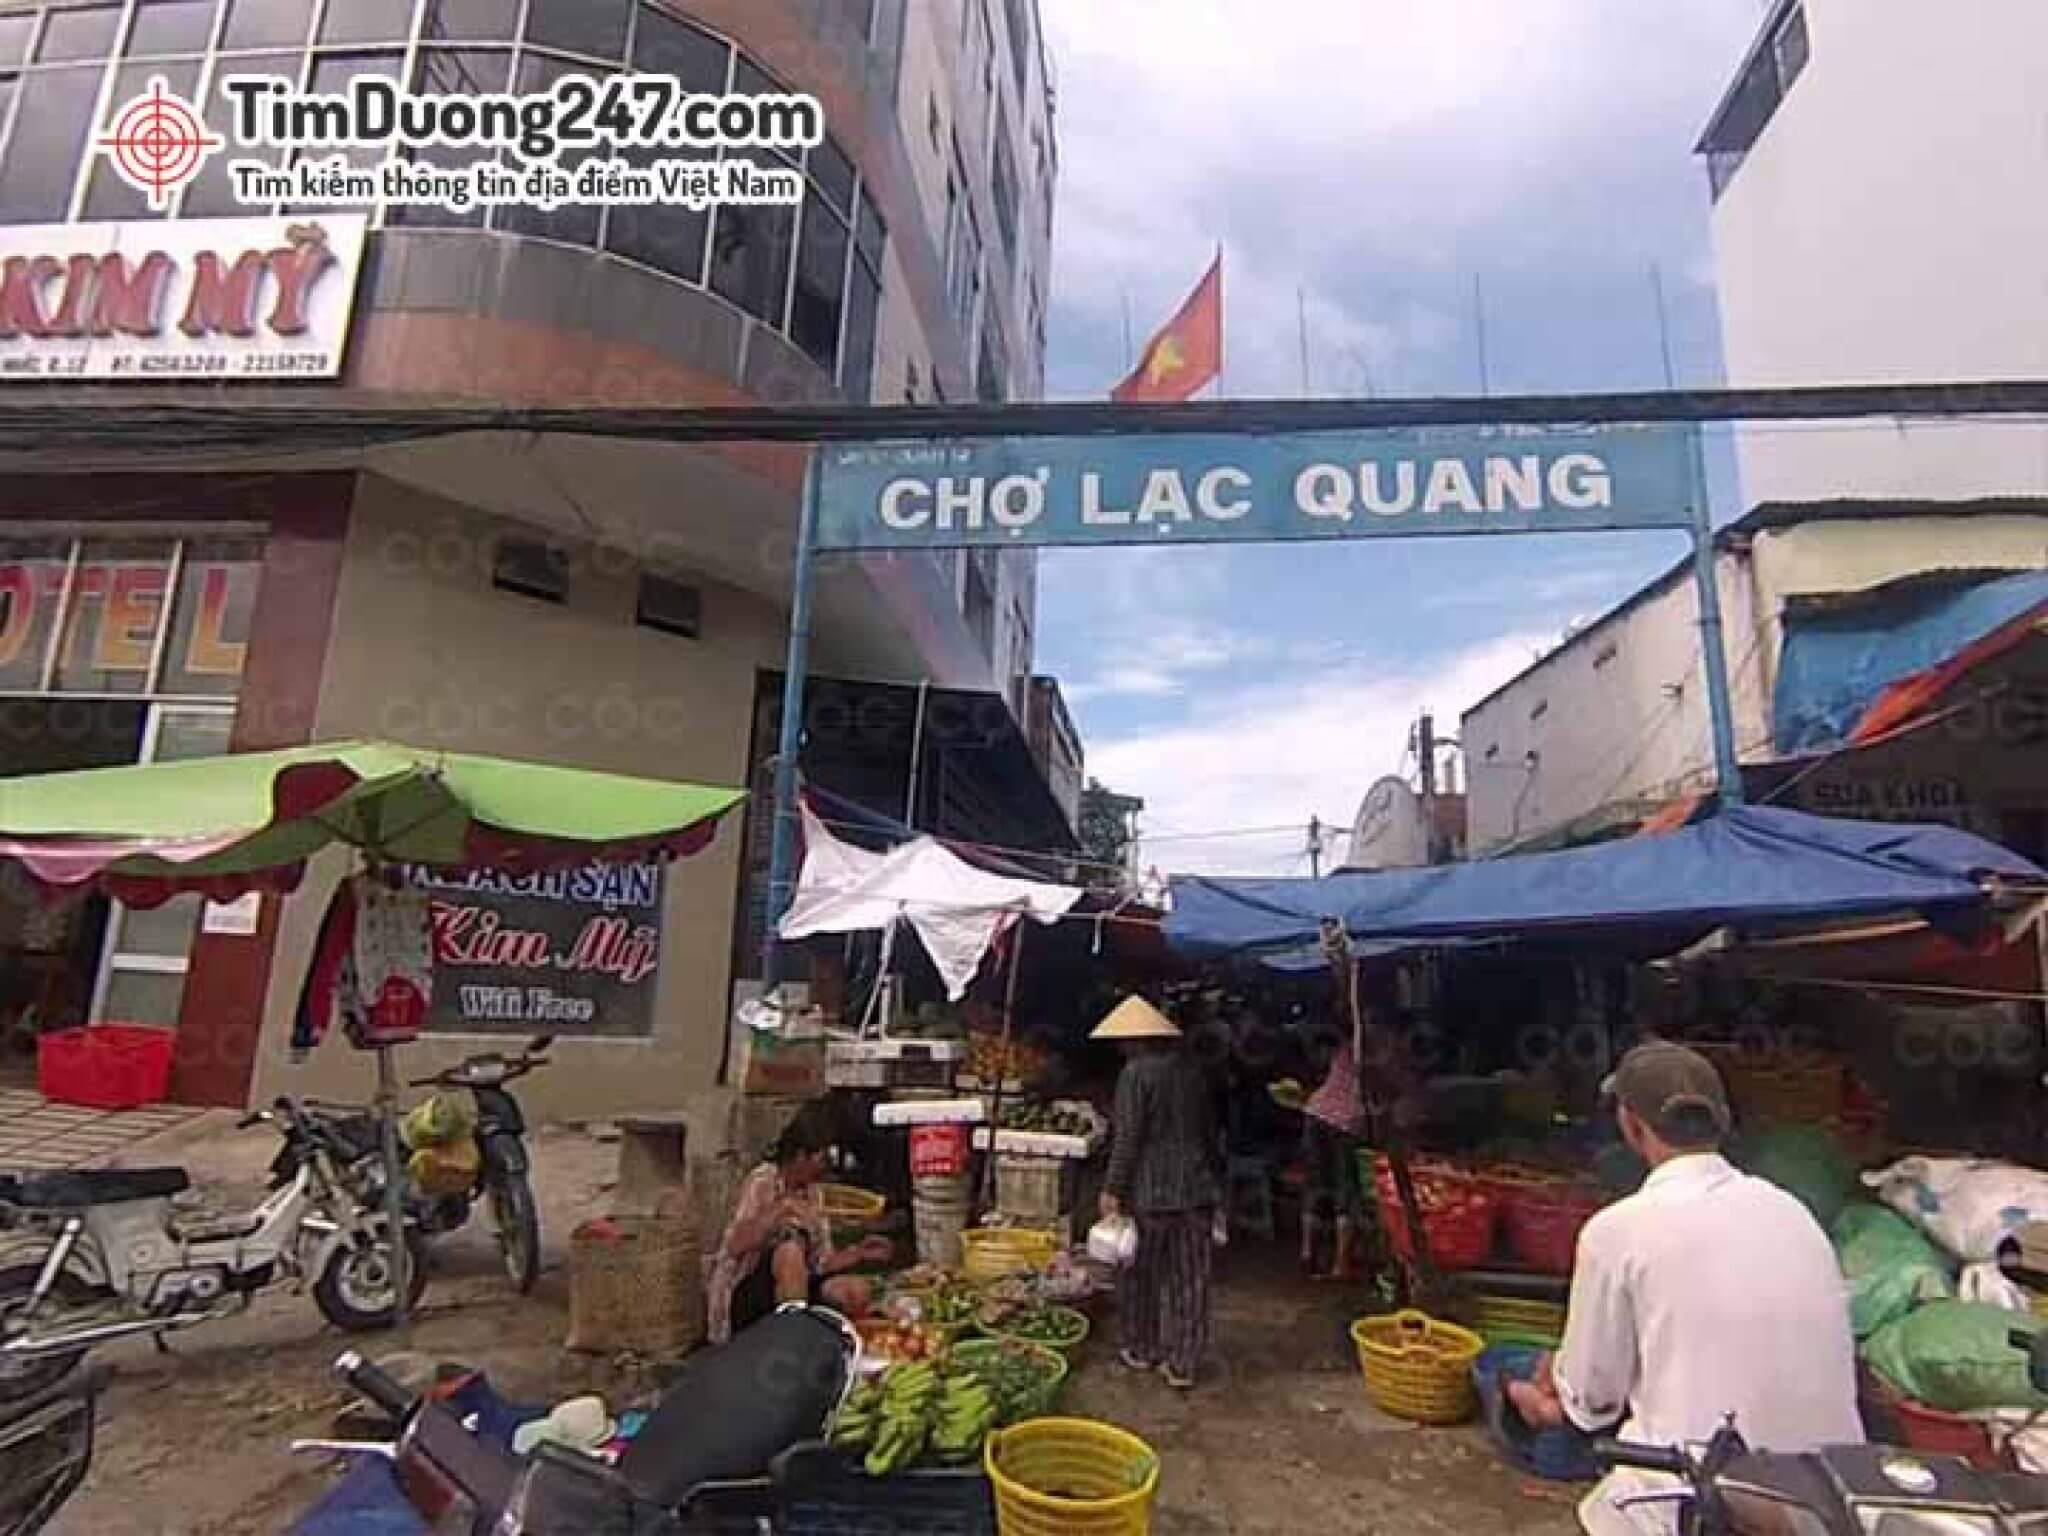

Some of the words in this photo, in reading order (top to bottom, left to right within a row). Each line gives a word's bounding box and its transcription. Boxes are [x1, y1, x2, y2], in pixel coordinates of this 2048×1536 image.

[0, 250, 178, 338] KIM
[880, 465, 1049, 537] CHỢ
[1081, 465, 1252, 535] LẠC
[1293, 452, 1612, 522] QUANG
[431, 902, 550, 968] Kim
